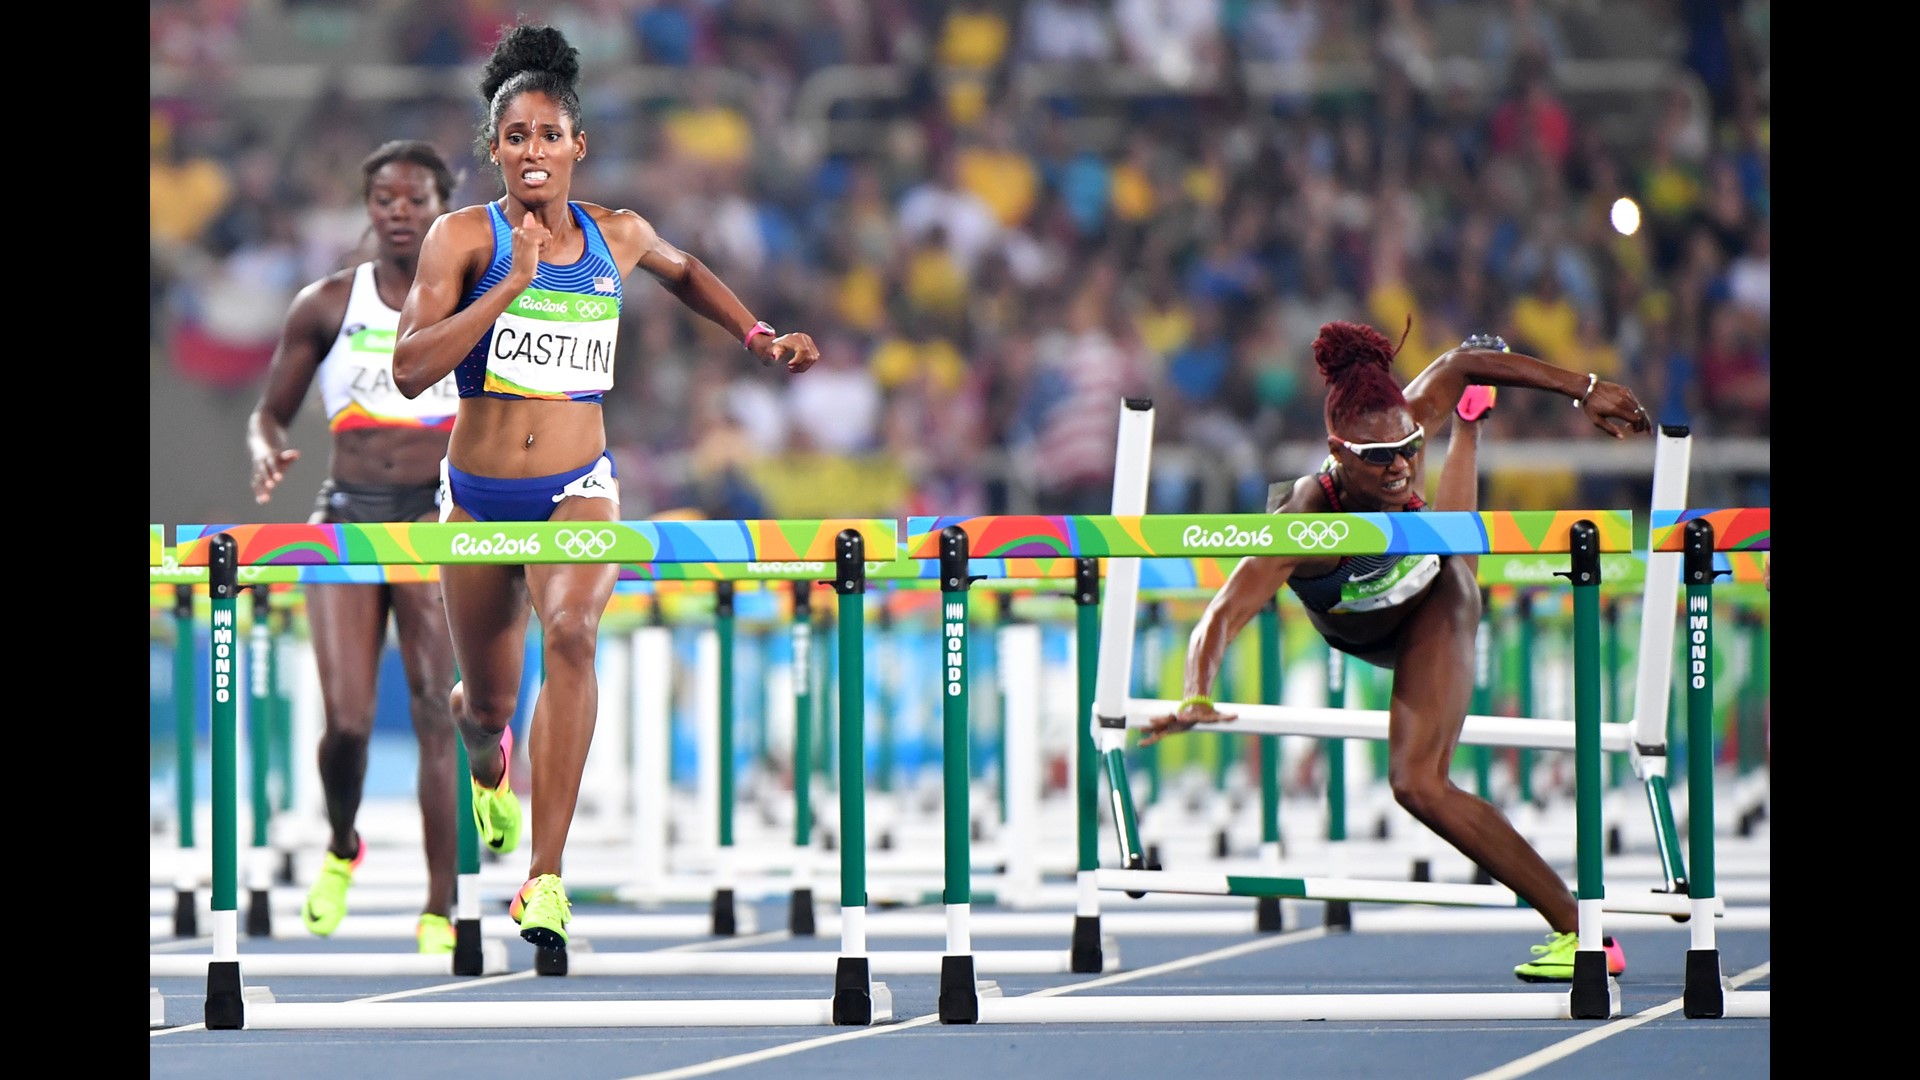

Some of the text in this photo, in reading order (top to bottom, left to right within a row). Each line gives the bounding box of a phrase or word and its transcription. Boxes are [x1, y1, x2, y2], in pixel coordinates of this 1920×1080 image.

[519, 295, 568, 314] Rio2016
[494, 328, 611, 374] CASTLIN
[350, 365, 457, 399] ZAE
[451, 532, 541, 556] Rio2016
[1182, 524, 1274, 548] Rio2016
[214, 629, 232, 703] MONDO
[946, 622, 964, 696] MONDO
[1690, 615, 1708, 689] MONDO
